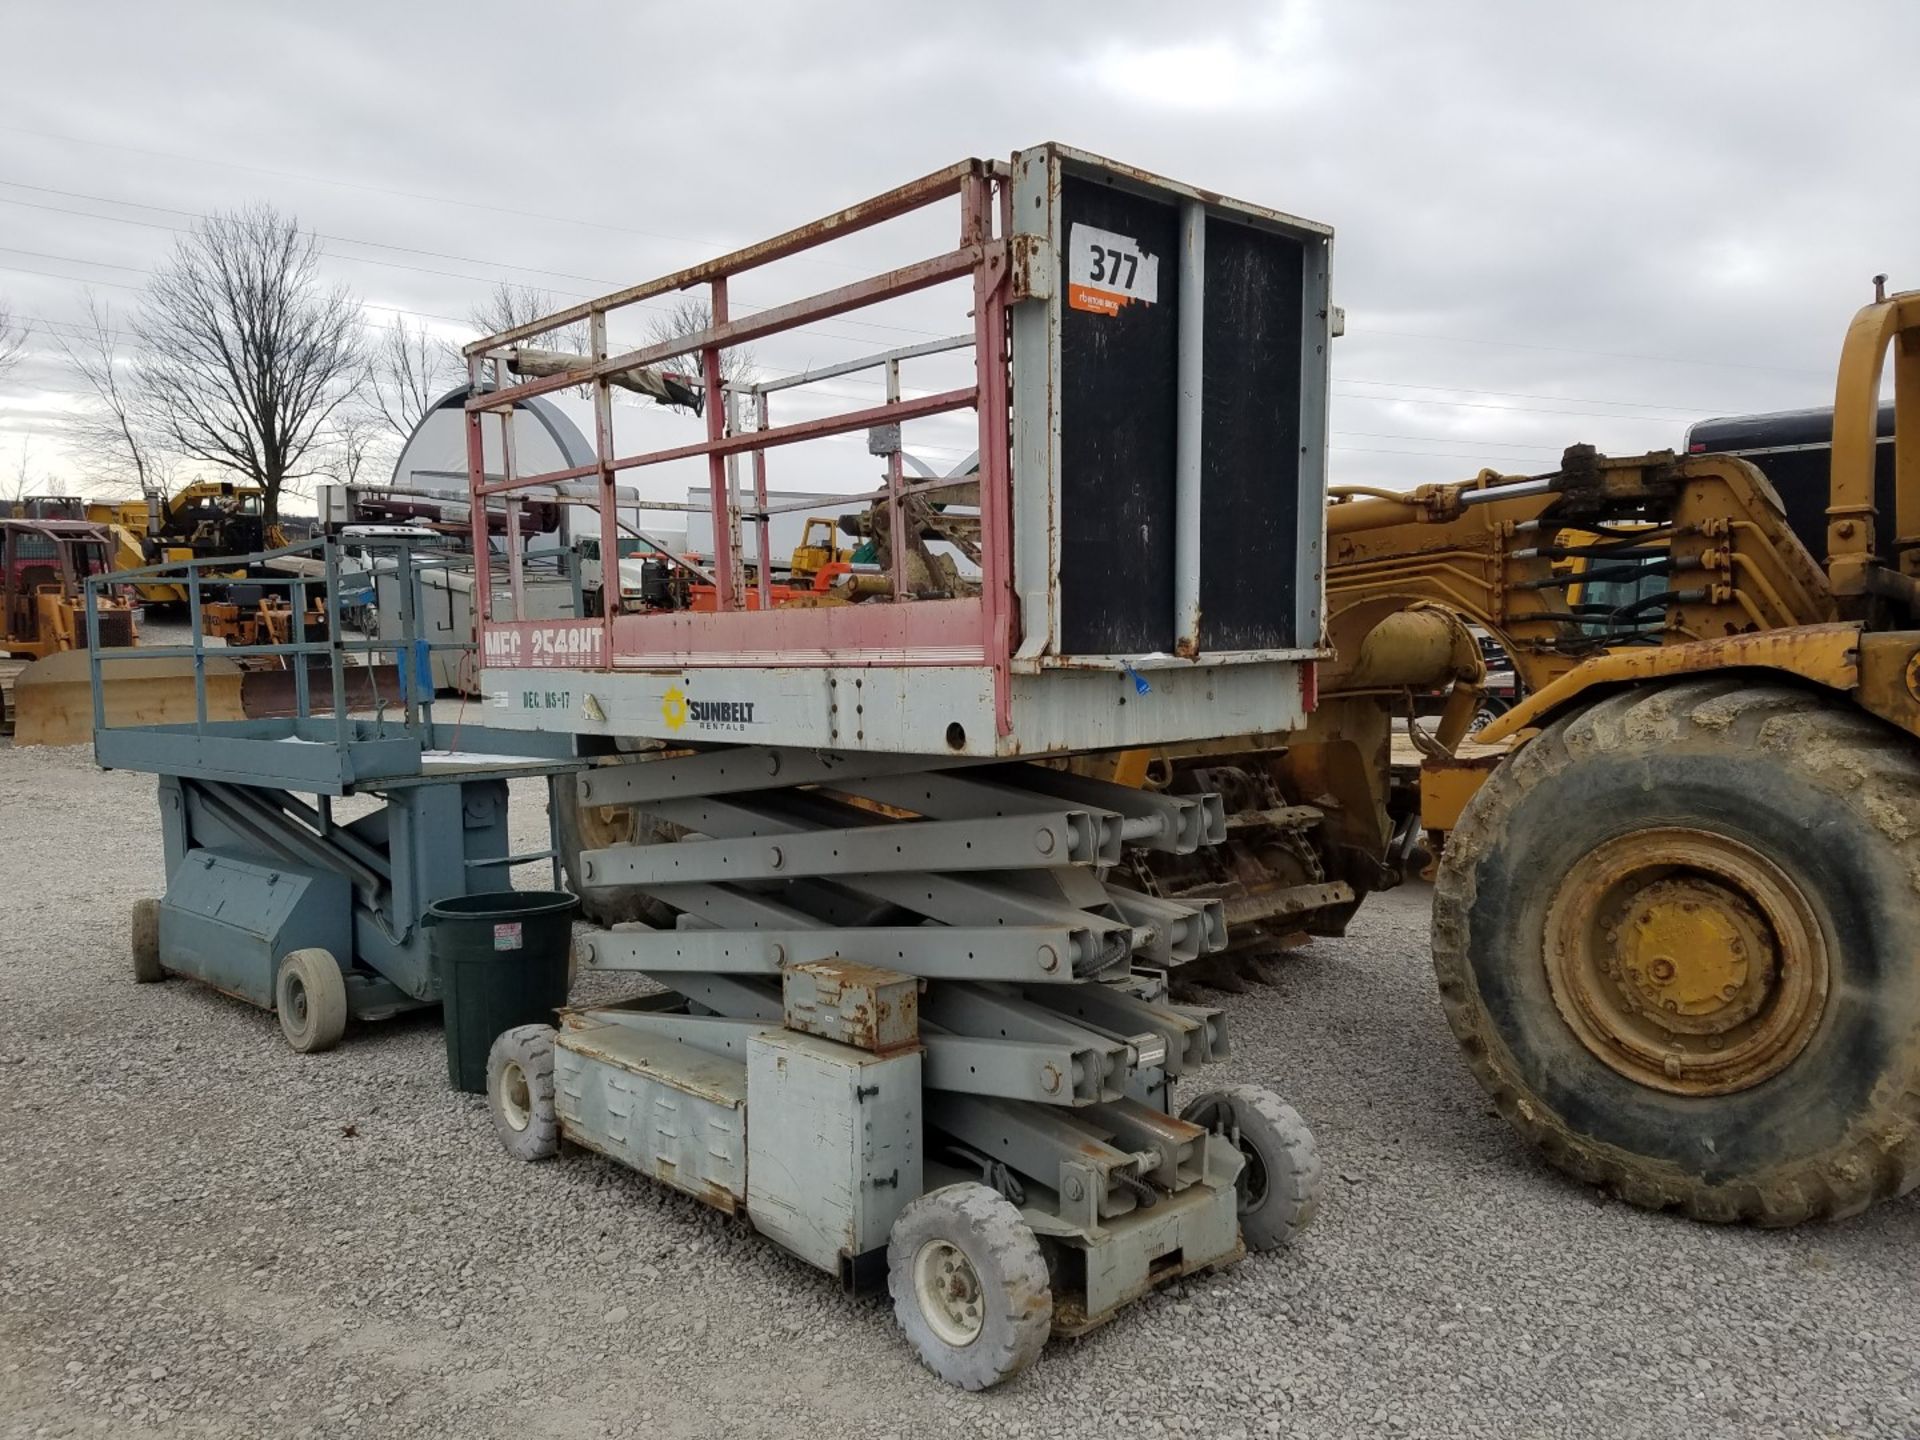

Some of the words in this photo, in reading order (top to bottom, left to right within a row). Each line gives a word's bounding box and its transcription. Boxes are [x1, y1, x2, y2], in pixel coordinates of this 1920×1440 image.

[1090, 245, 1138, 290] 377
[485, 630, 521, 667] MEC
[531, 627, 603, 666] 2548HT
[690, 701, 754, 722] SUNBELT
[700, 722, 745, 731] RENTALS
